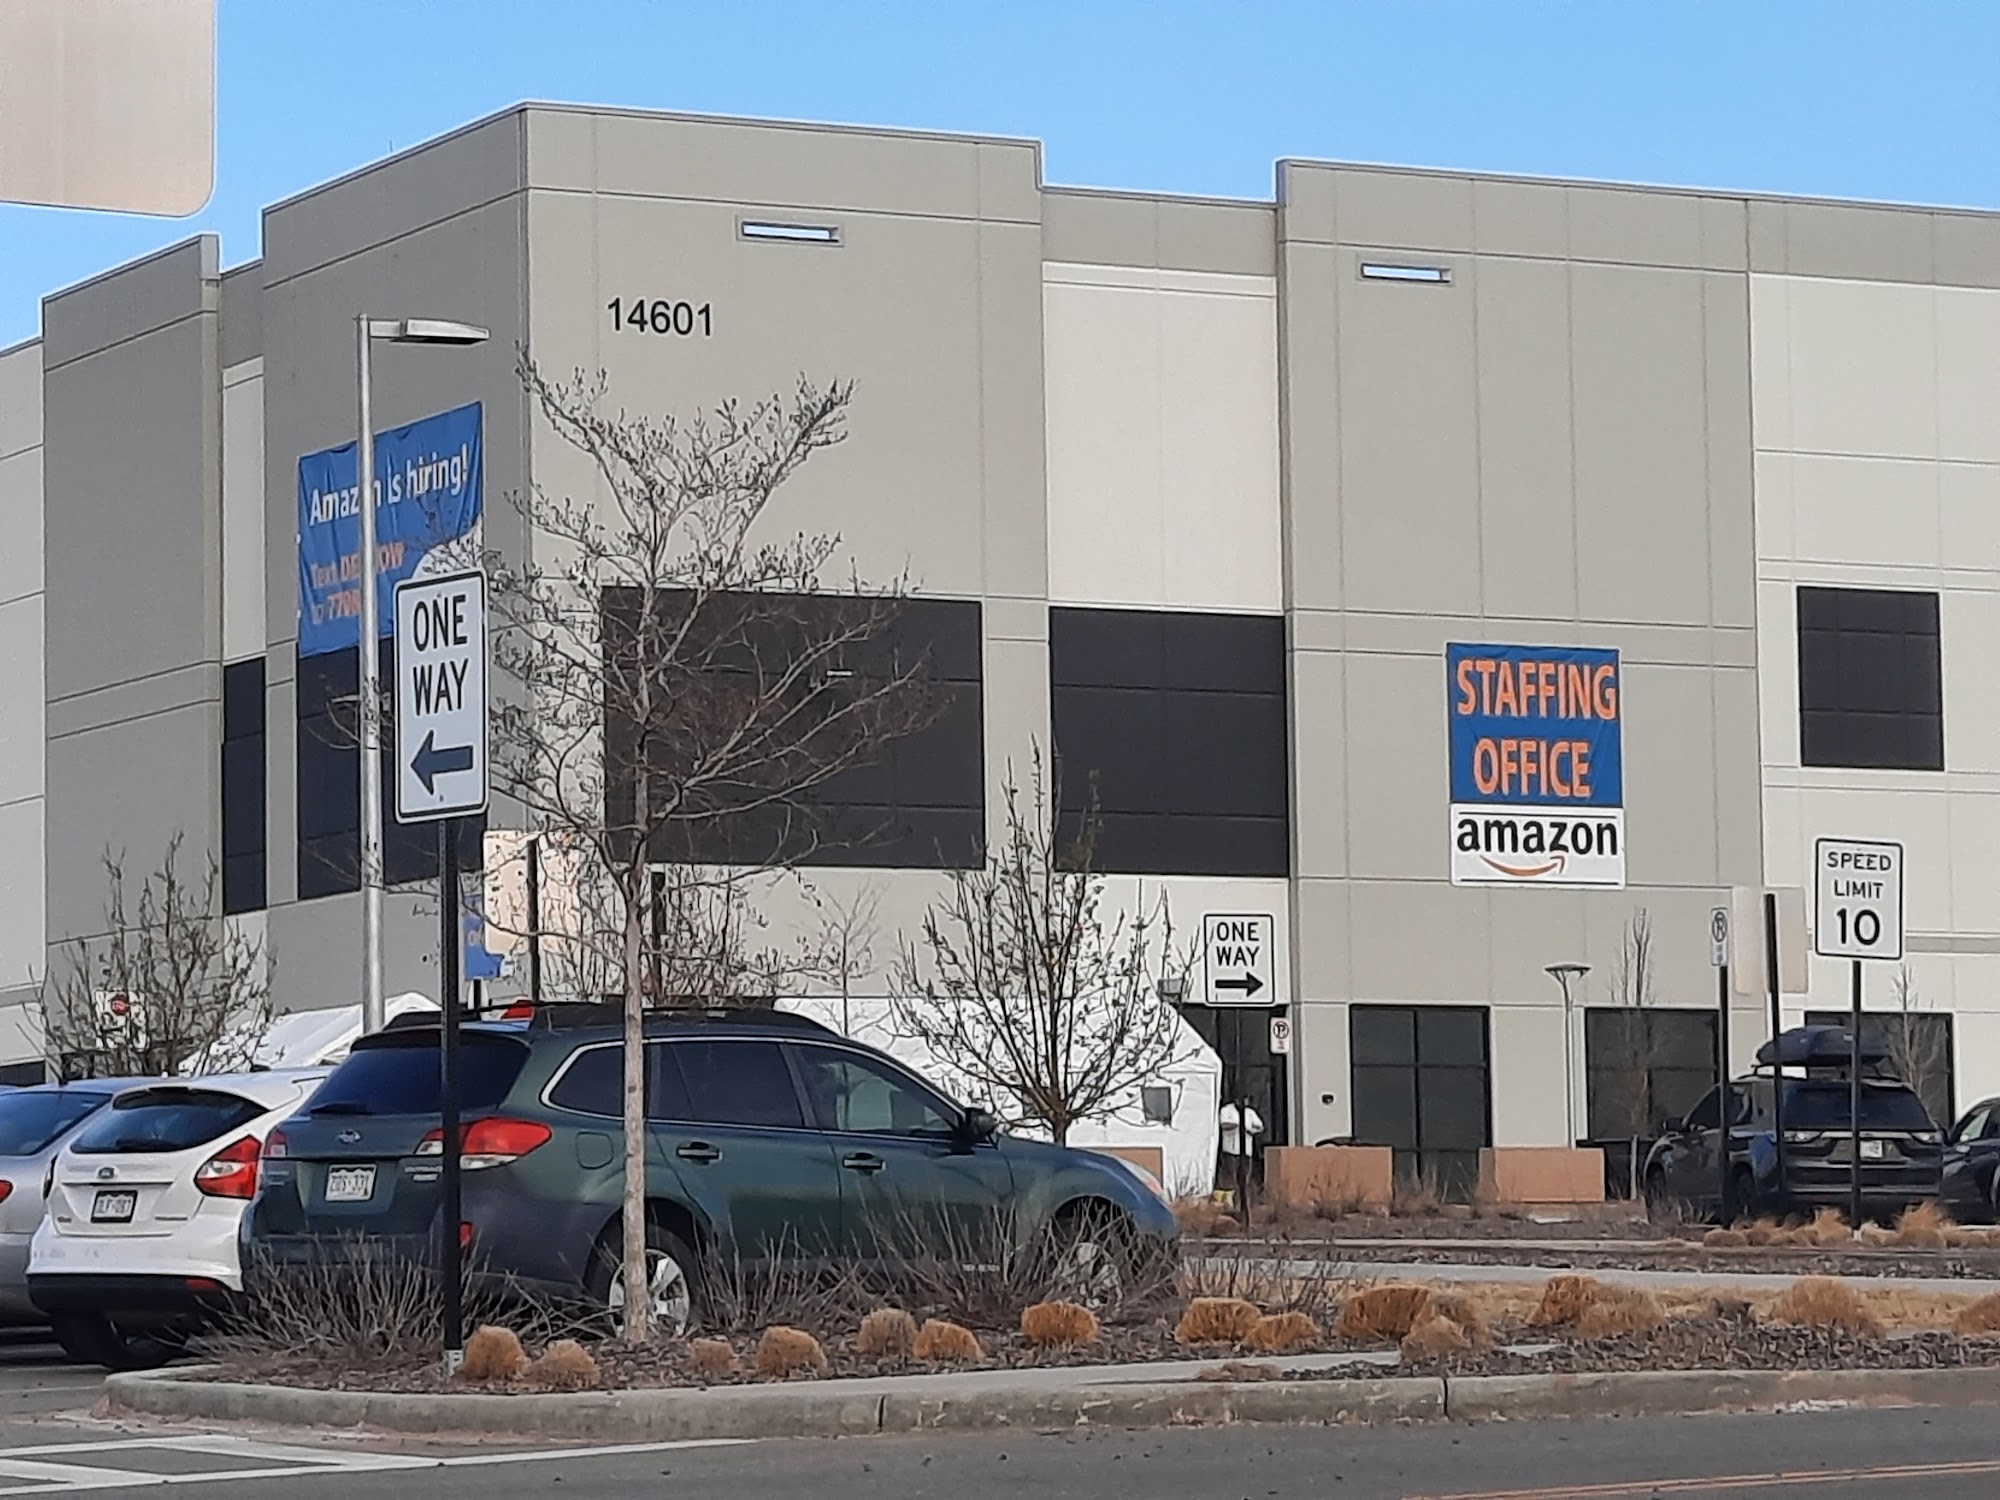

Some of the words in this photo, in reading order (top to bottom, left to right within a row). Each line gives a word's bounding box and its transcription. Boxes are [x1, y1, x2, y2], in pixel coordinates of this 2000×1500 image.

[608, 297, 710, 336] 14601
[309, 479, 382, 527] Amazn
[386, 459, 402, 504] is
[406, 443, 468, 499] hiring!
[413, 594, 468, 652] ONE
[413, 658, 469, 717] WAY
[1456, 658, 1617, 721] STAFFING
[1473, 737, 1592, 797] OFFICE
[1457, 818, 1618, 856] amazon
[1826, 851, 1892, 871] SPEED
[1833, 879, 1884, 899] LIMIT
[1216, 921, 1260, 942] ONE
[1836, 907, 1881, 946] 10
[1216, 945, 1260, 967] WAY
